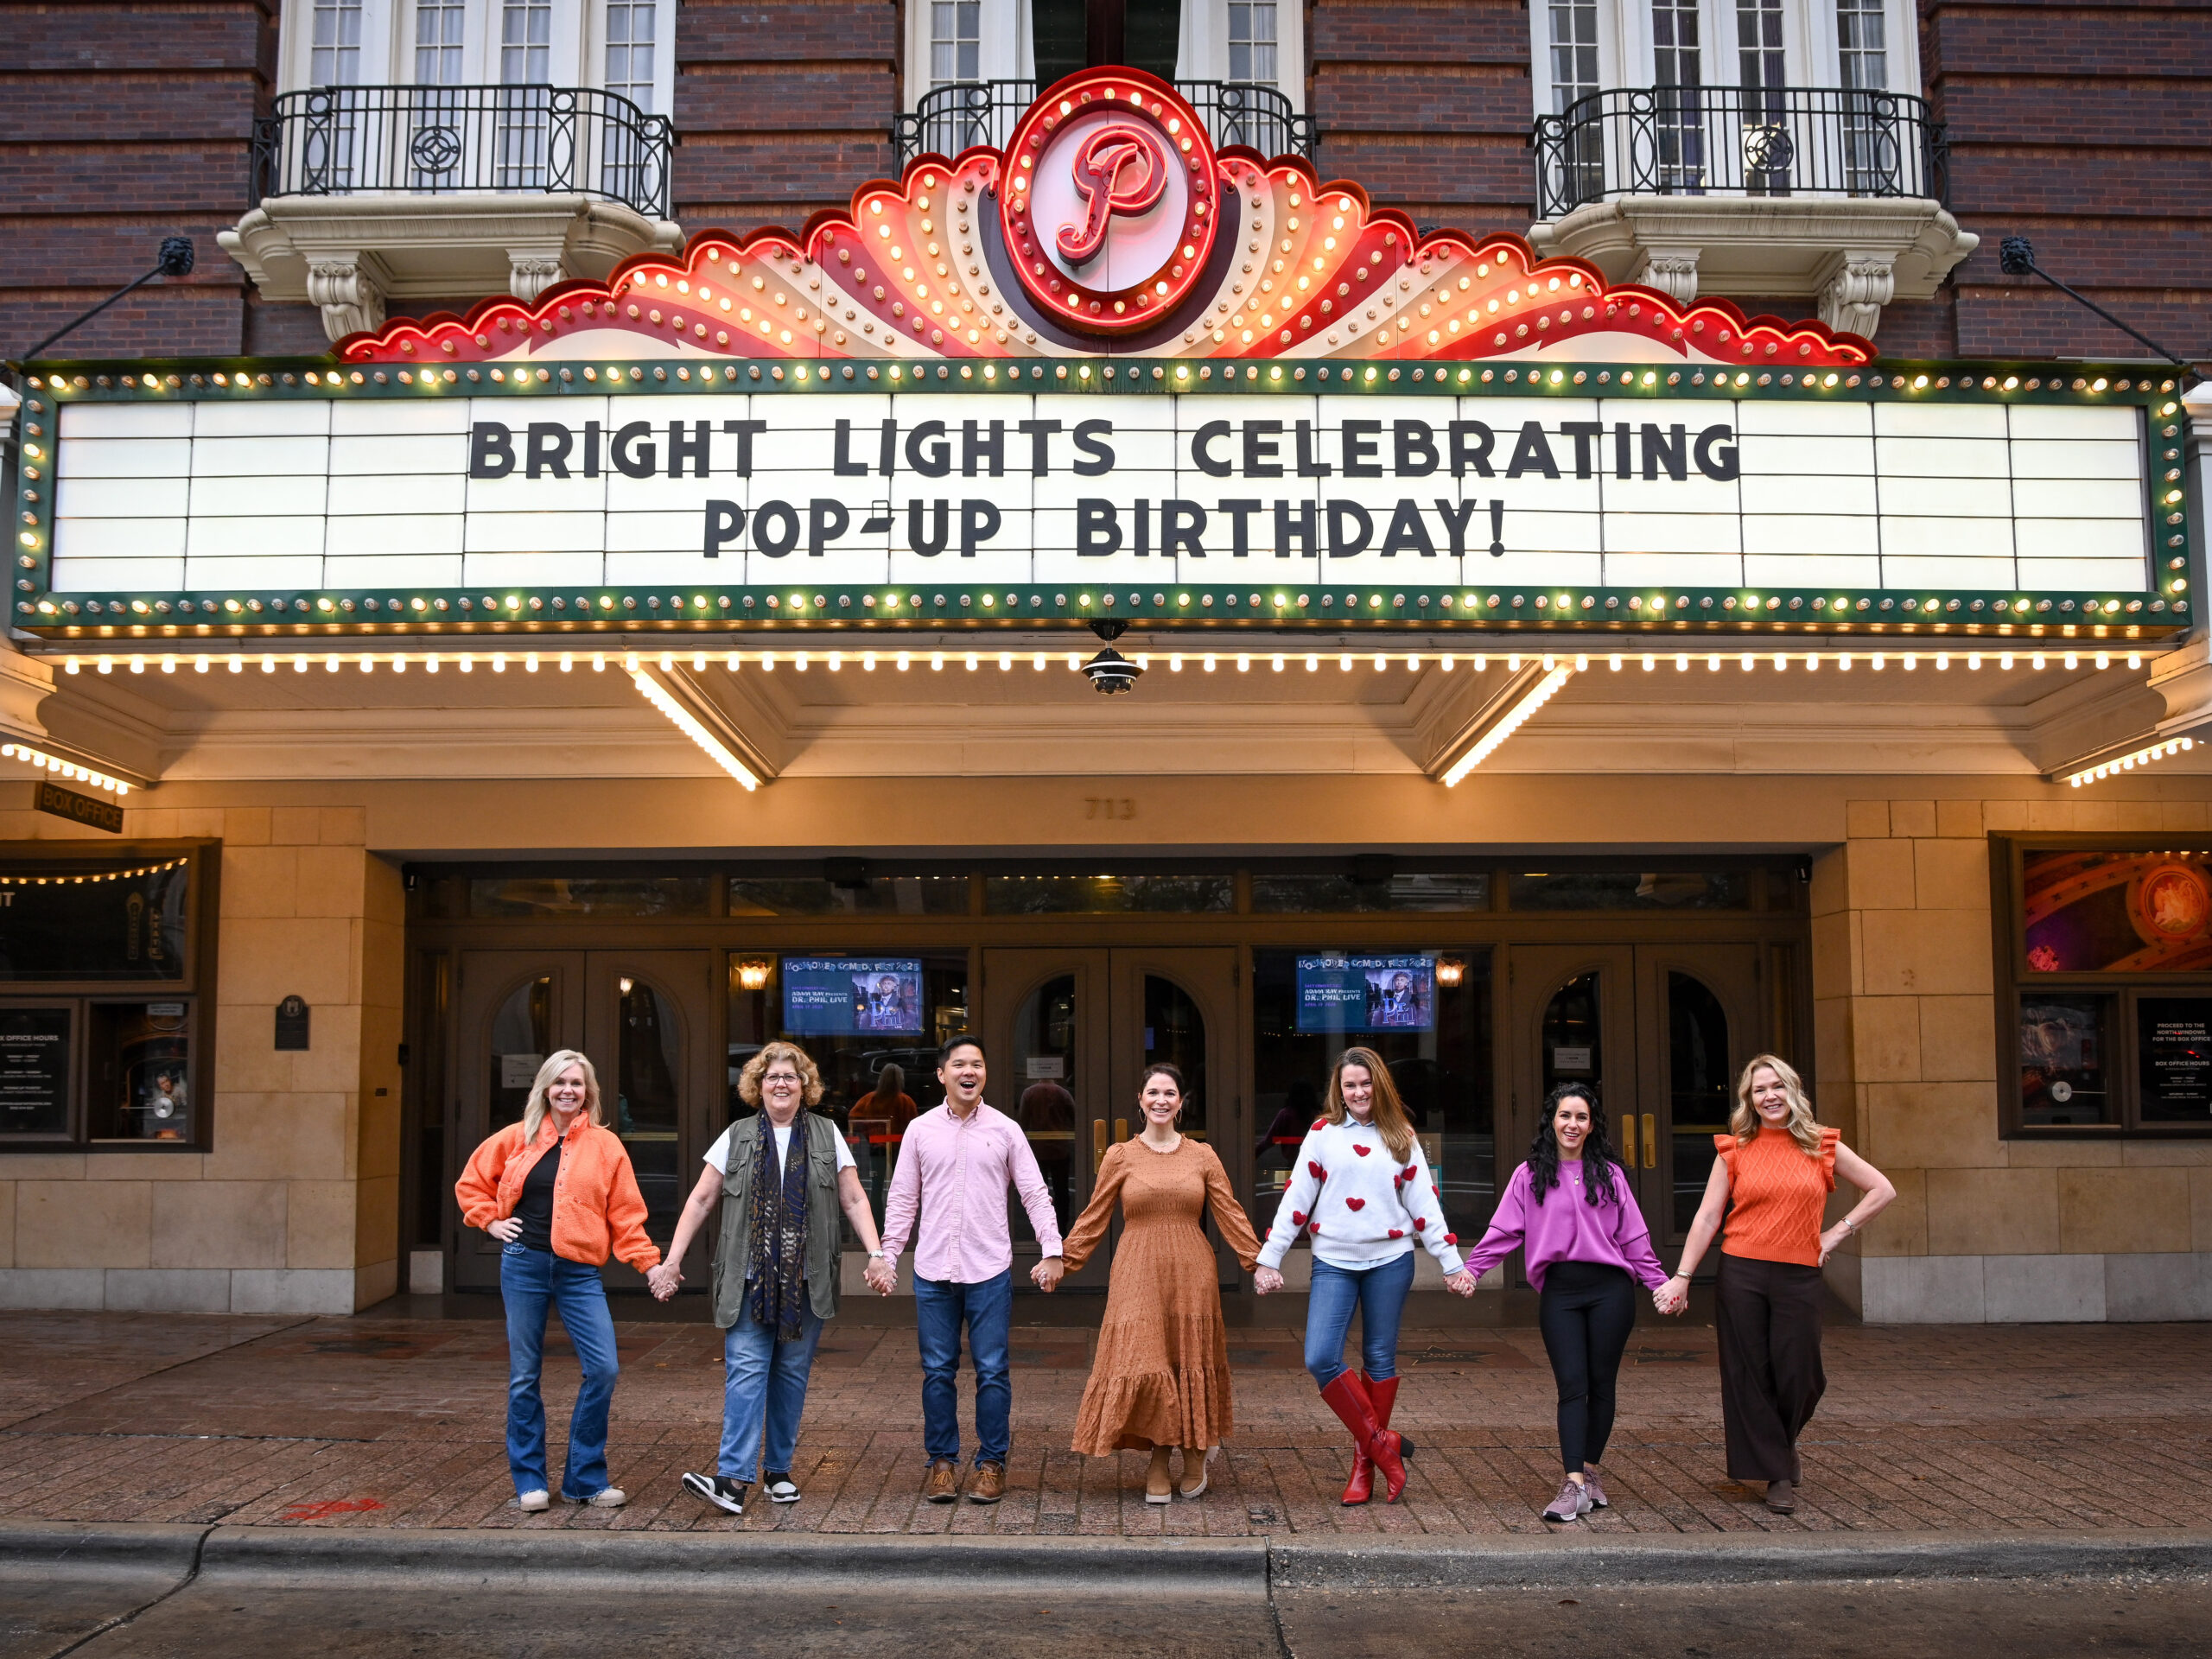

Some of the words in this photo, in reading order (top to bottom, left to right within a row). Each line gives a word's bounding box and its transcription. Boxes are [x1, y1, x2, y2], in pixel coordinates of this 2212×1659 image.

[468, 419, 767, 480] BRIGHT
[834, 419, 1116, 478] LIGHTS
[1191, 419, 1740, 481] CELEBRATING
[703, 498, 1001, 558] POP-UP
[1077, 498, 1504, 558] BIRTHDAY!
[43, 787, 73, 811] BOX
[75, 798, 121, 828] OFFICE
[1085, 797, 1135, 820] 713
